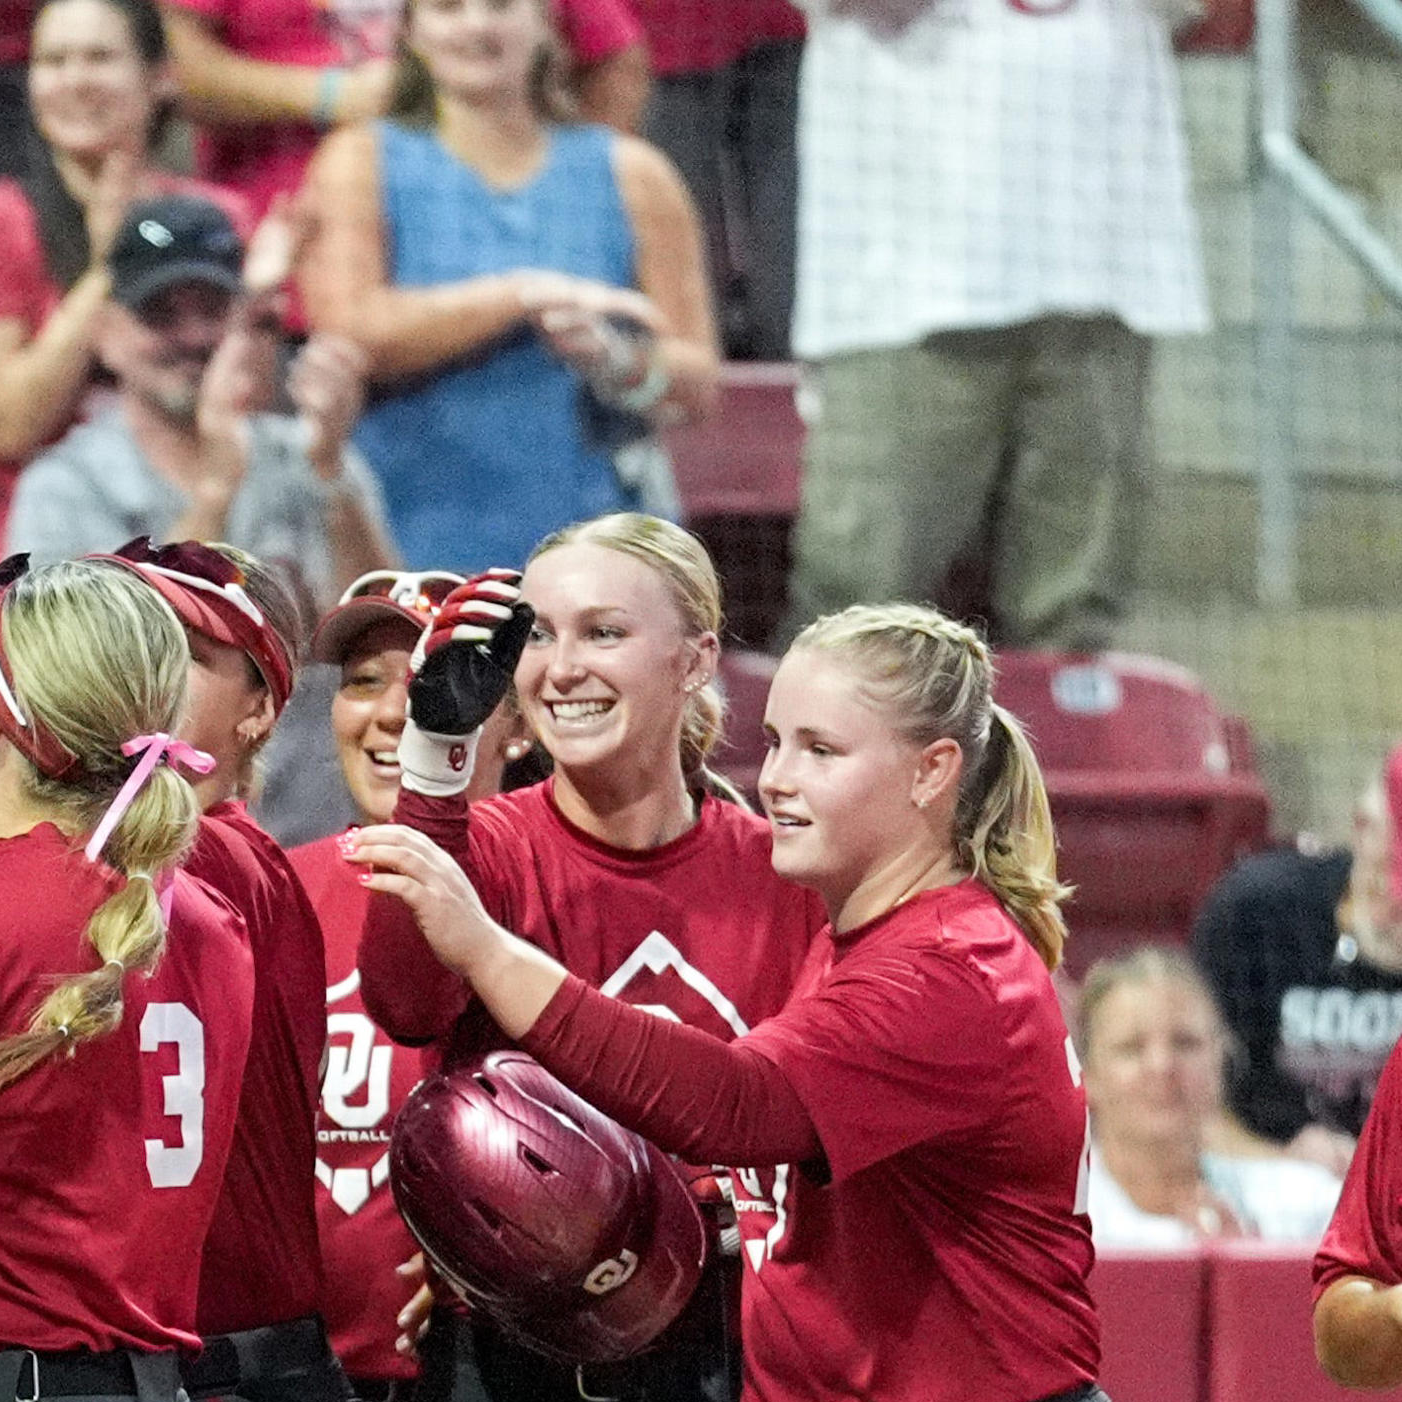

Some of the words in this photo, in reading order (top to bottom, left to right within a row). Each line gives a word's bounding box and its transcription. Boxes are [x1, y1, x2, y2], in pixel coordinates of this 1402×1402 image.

[448, 743, 468, 772] OU
[1280, 985, 1402, 1050] SOO
[139, 1002, 205, 1188] 3
[322, 1012, 394, 1128] OU
[317, 1130, 391, 1142] OFTBALL
[583, 1247, 639, 1295] OU
